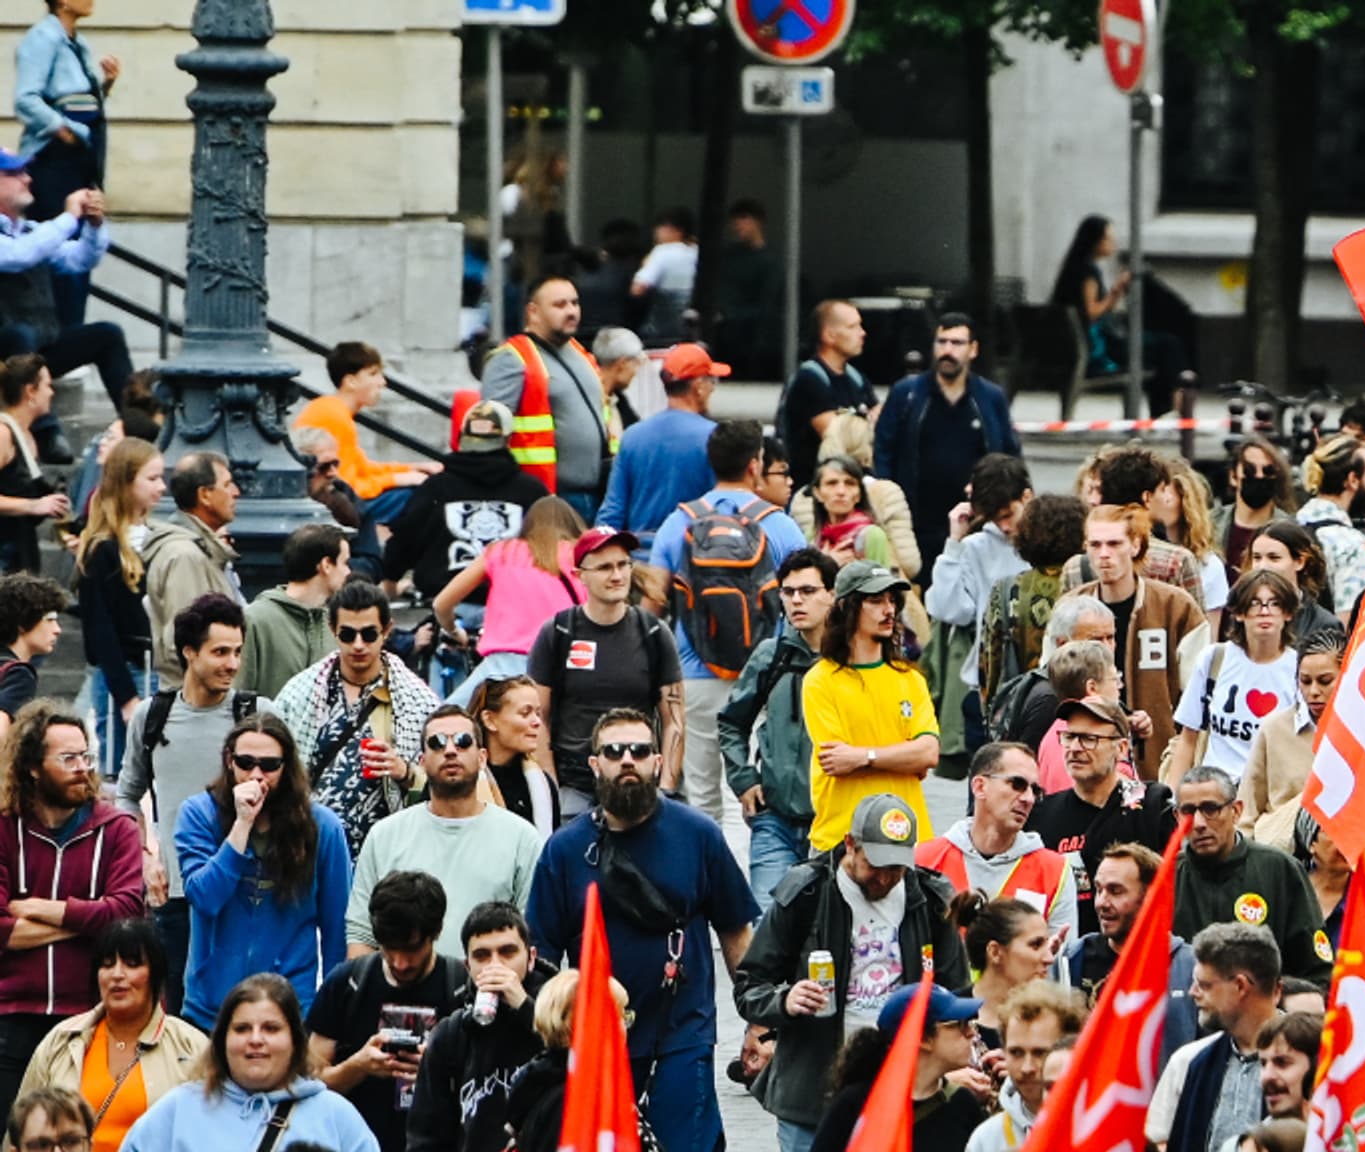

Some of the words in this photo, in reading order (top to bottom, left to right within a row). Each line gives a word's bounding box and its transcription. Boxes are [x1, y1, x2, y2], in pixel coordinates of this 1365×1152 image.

[1138, 628, 1167, 670] B
[1223, 684, 1239, 713] I
[1240, 903, 1263, 921] cgt
